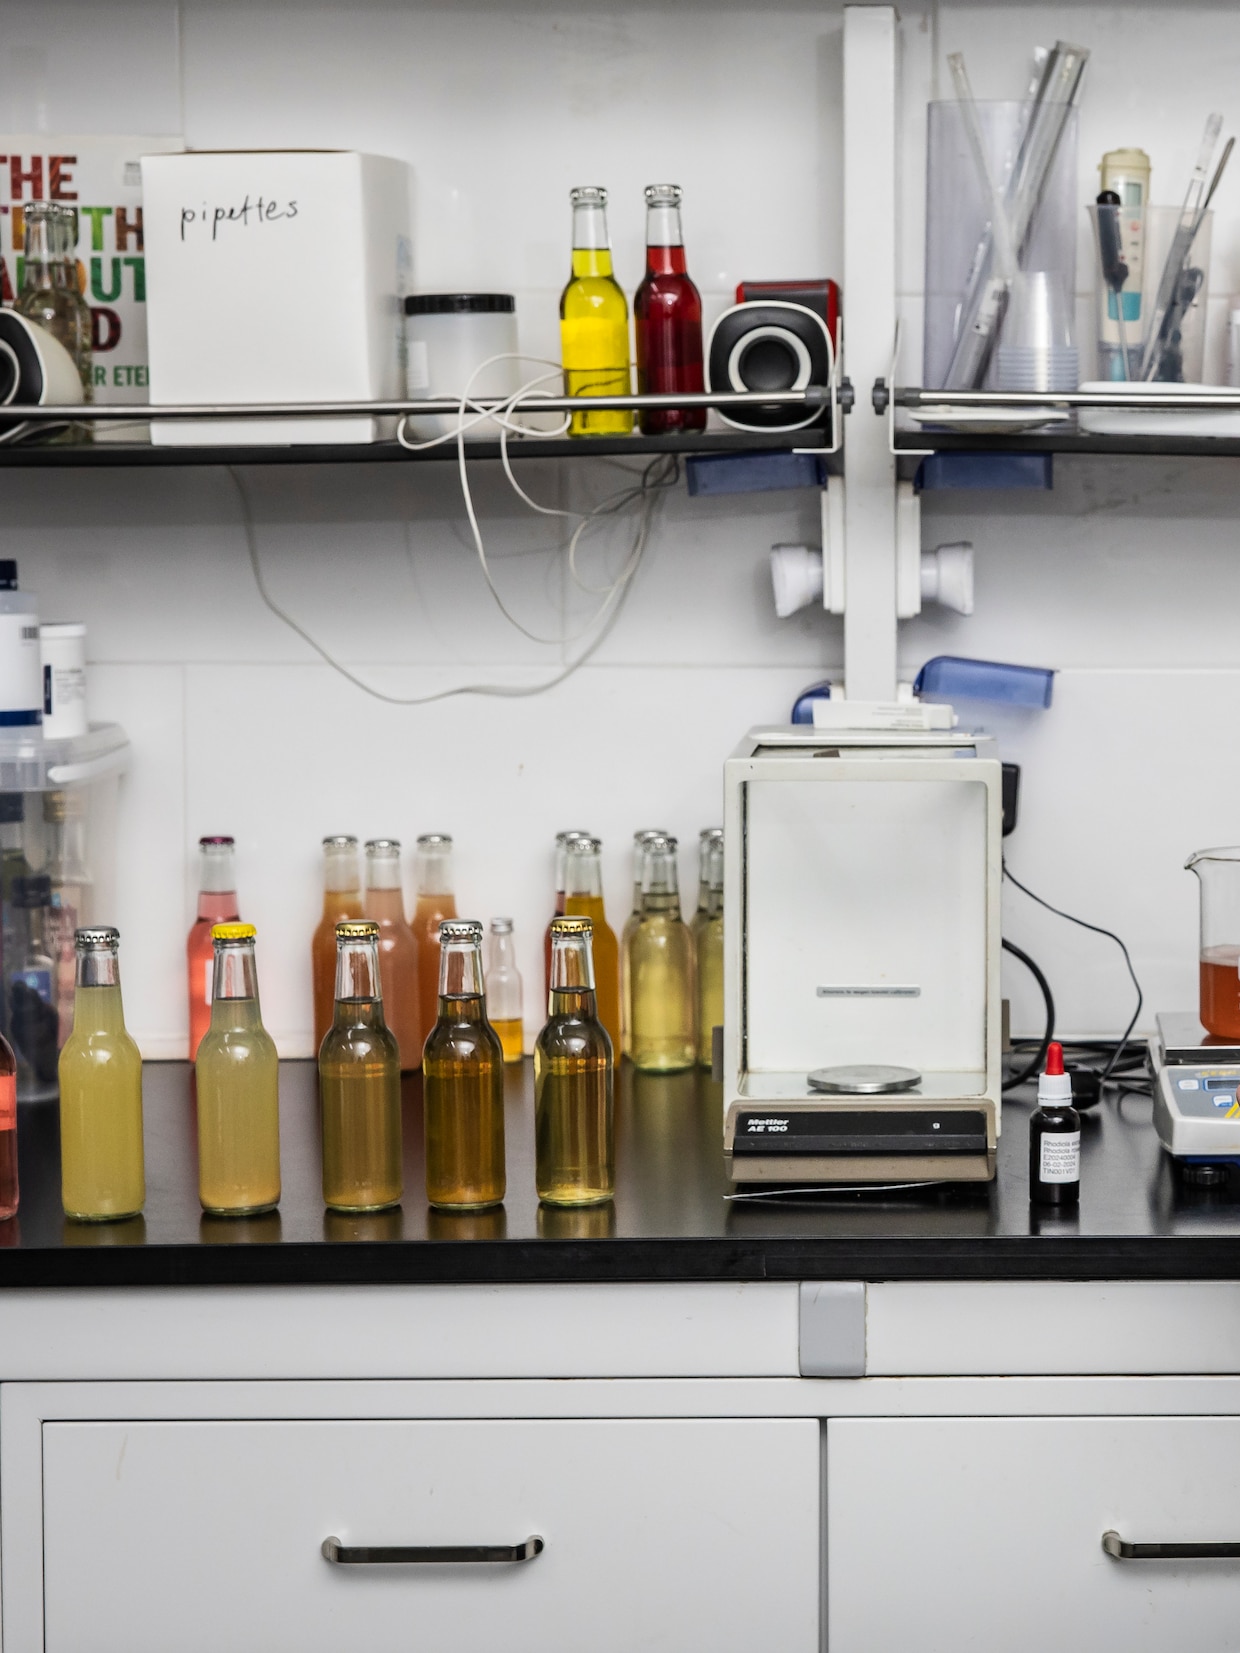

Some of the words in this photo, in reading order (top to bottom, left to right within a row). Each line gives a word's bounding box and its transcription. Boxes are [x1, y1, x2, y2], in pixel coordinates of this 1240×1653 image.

[0, 155, 78, 200] HE
[180, 194, 299, 242] pipettes
[747, 1118, 790, 1126] Mettler
[747, 1125, 766, 1133] AE
[767, 1125, 789, 1133] 100
